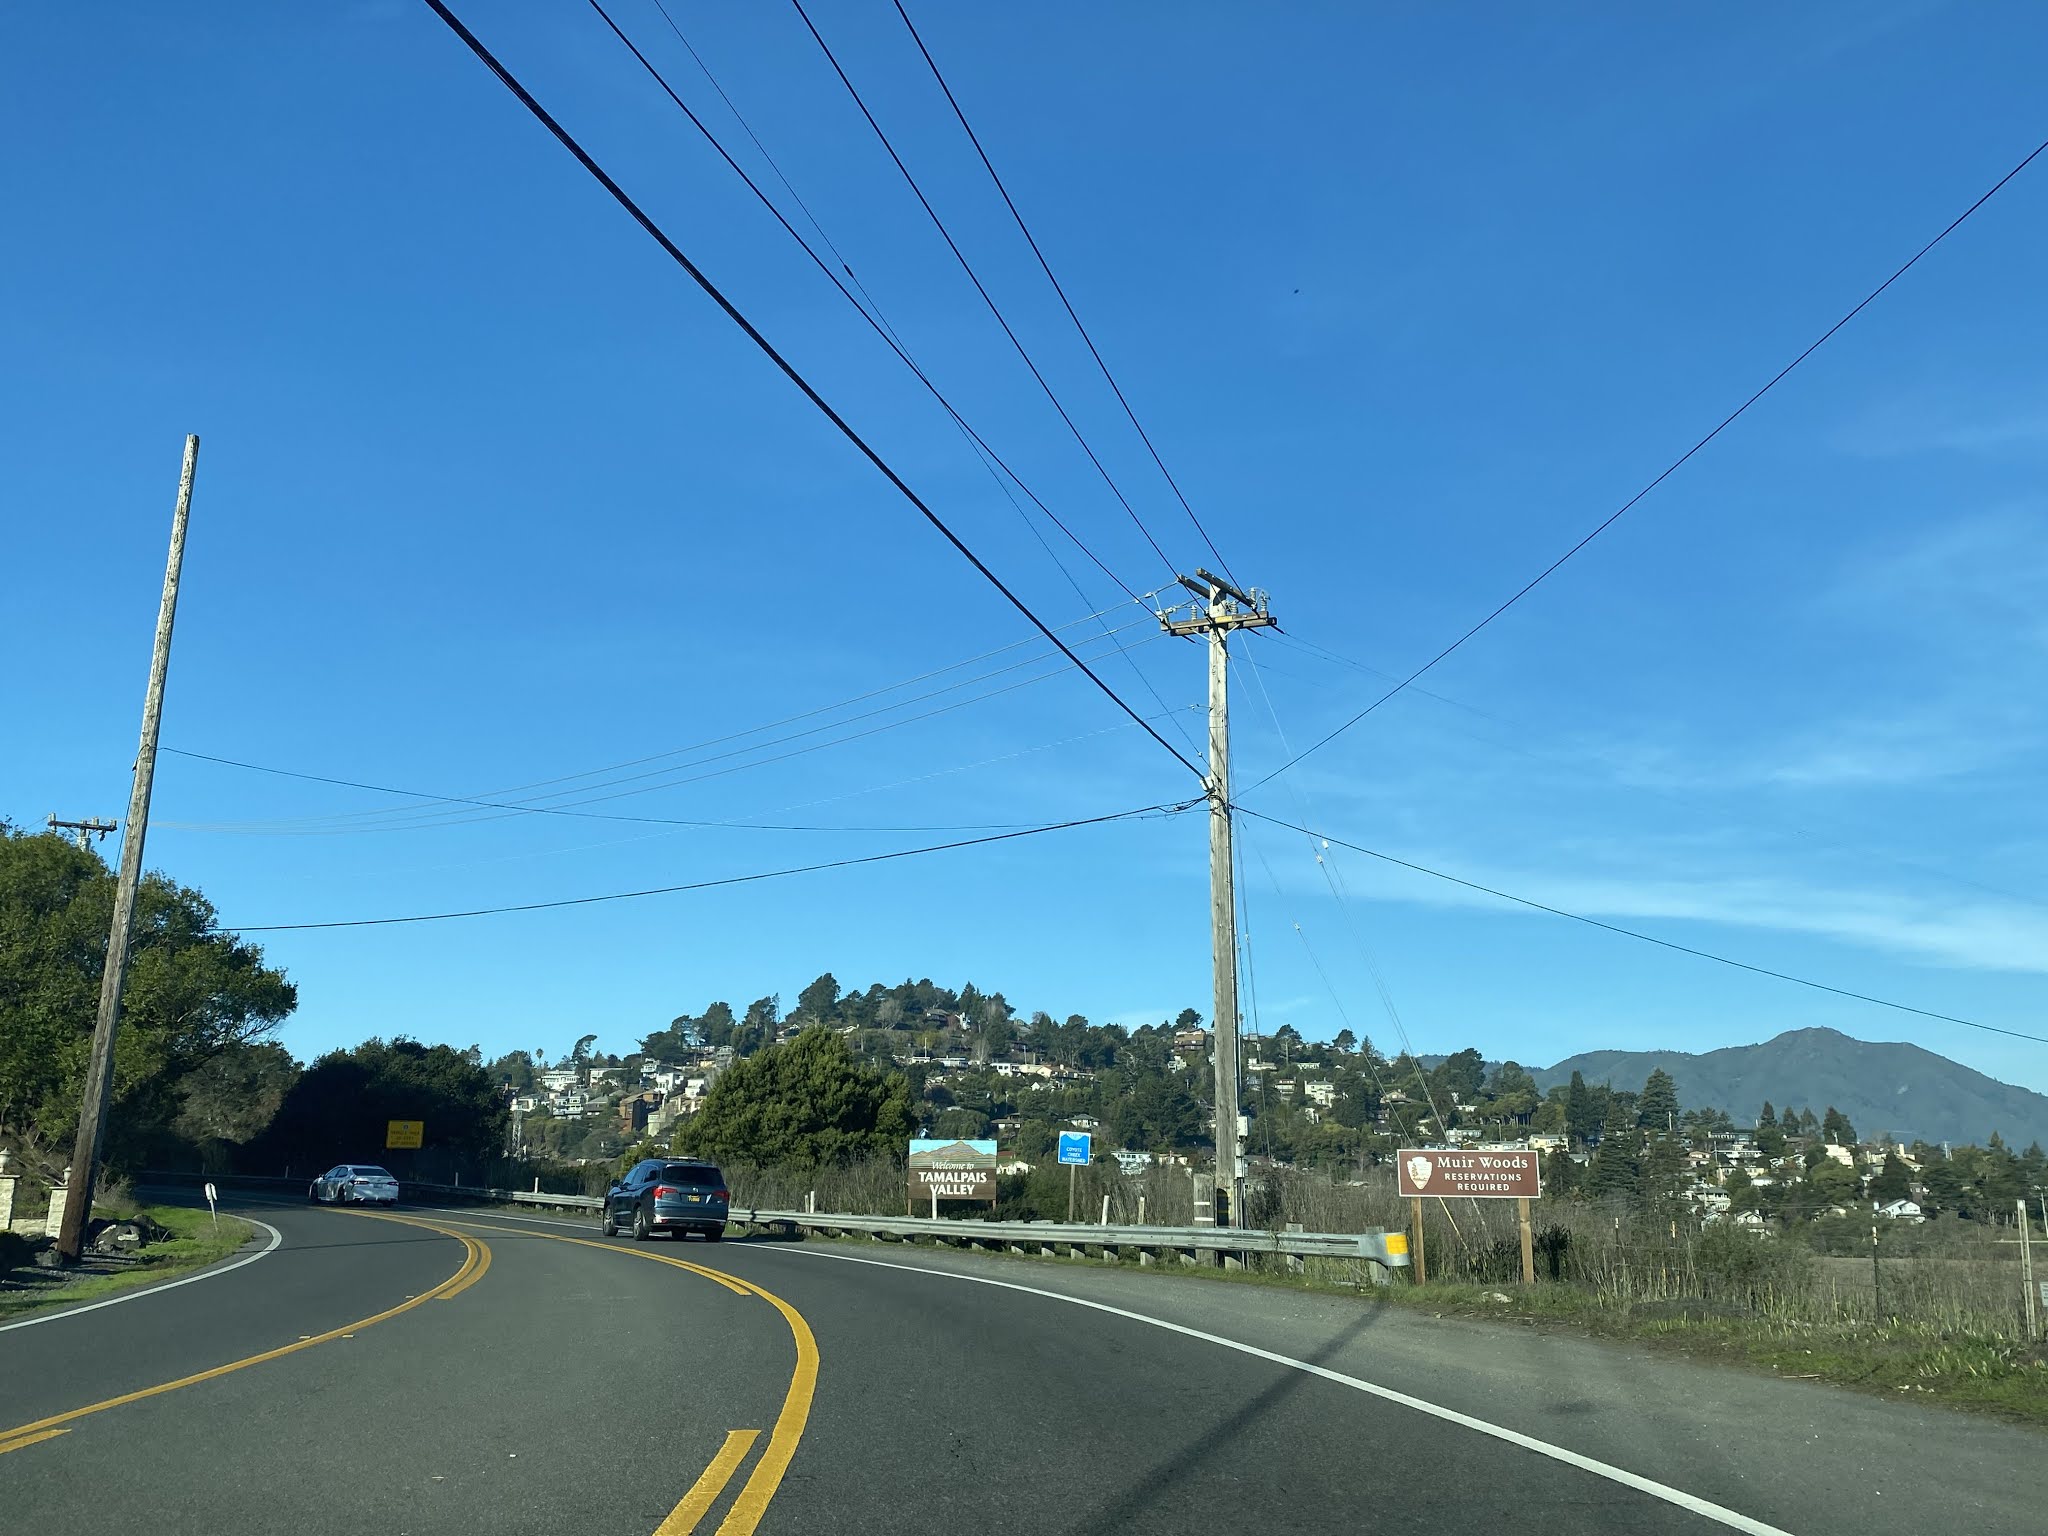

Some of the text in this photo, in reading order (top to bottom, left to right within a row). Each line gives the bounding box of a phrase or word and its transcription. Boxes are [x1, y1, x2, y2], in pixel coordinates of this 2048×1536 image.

[932, 1159, 975, 1170] Welcome to
[1437, 1155, 1529, 1169] Muir Woods
[918, 1171, 988, 1183] TAMALPAIS
[1444, 1172, 1522, 1182] RESERVATIONS
[929, 1184, 976, 1195] VALLEY
[1457, 1183, 1510, 1192] REQUIRED
